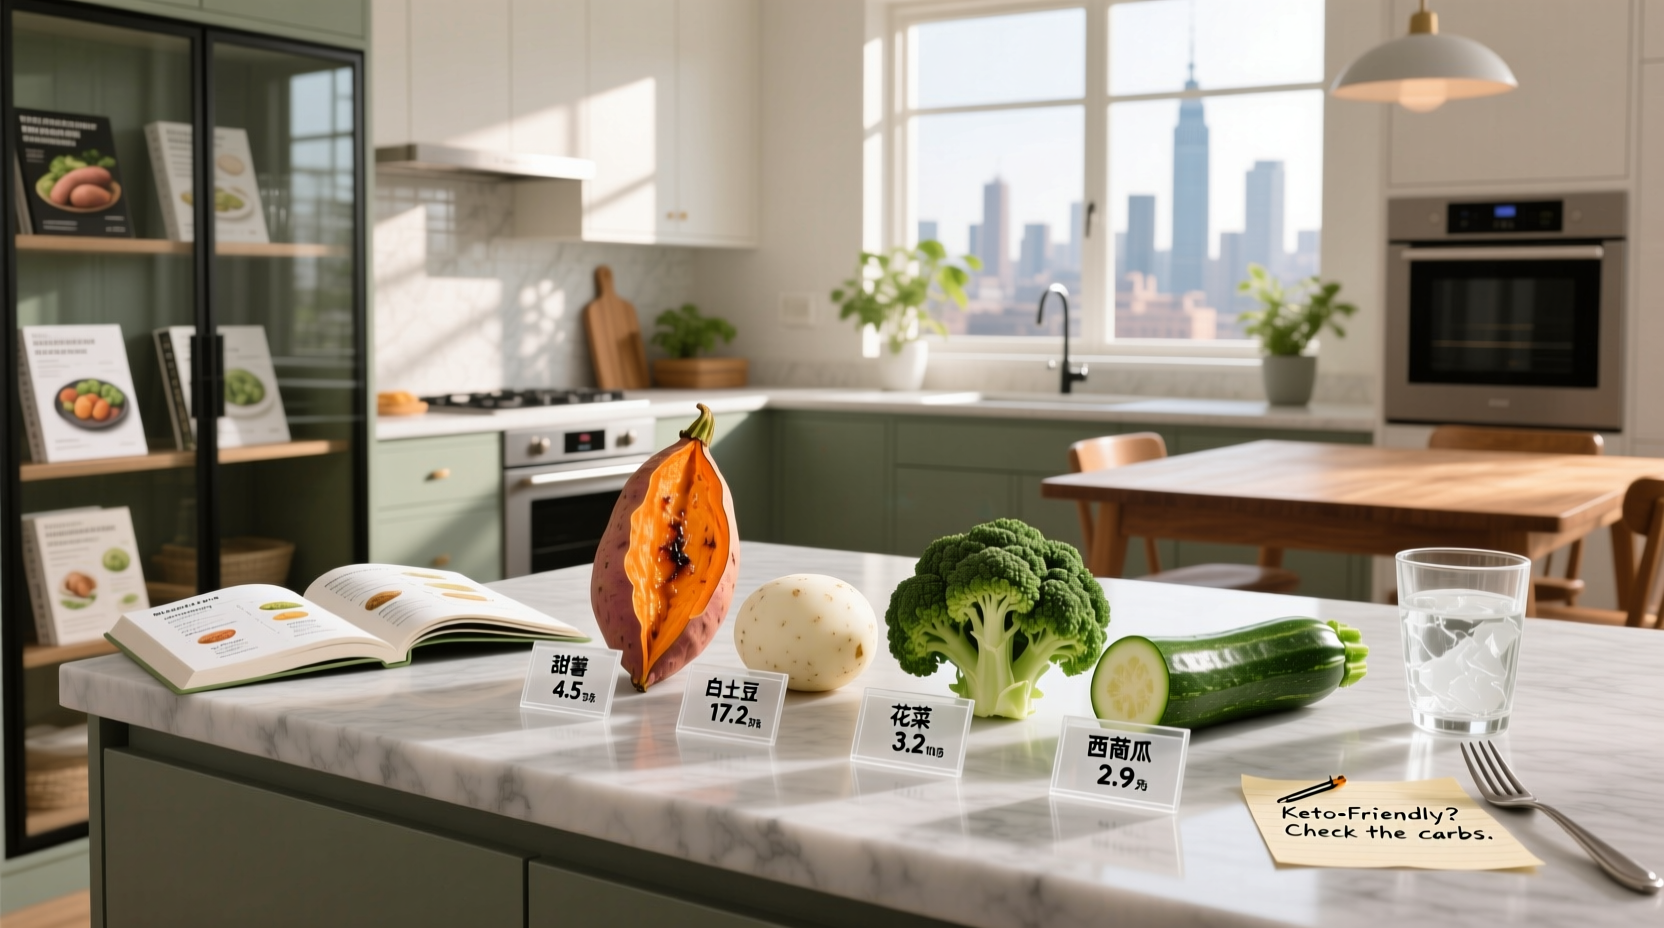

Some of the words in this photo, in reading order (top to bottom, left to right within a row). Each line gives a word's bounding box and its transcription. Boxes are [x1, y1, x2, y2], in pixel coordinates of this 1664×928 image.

[705, 677, 760, 703] 白土豆
[710, 702, 749, 726] 17.2
[890, 703, 933, 730] 花菜
[1096, 763, 1135, 789] 2.9
[1282, 806, 1459, 826] Keto-Friendly?
[1285, 823, 1358, 839] Check
[1365, 825, 1407, 840] the
[1418, 825, 1493, 841] carbs.
